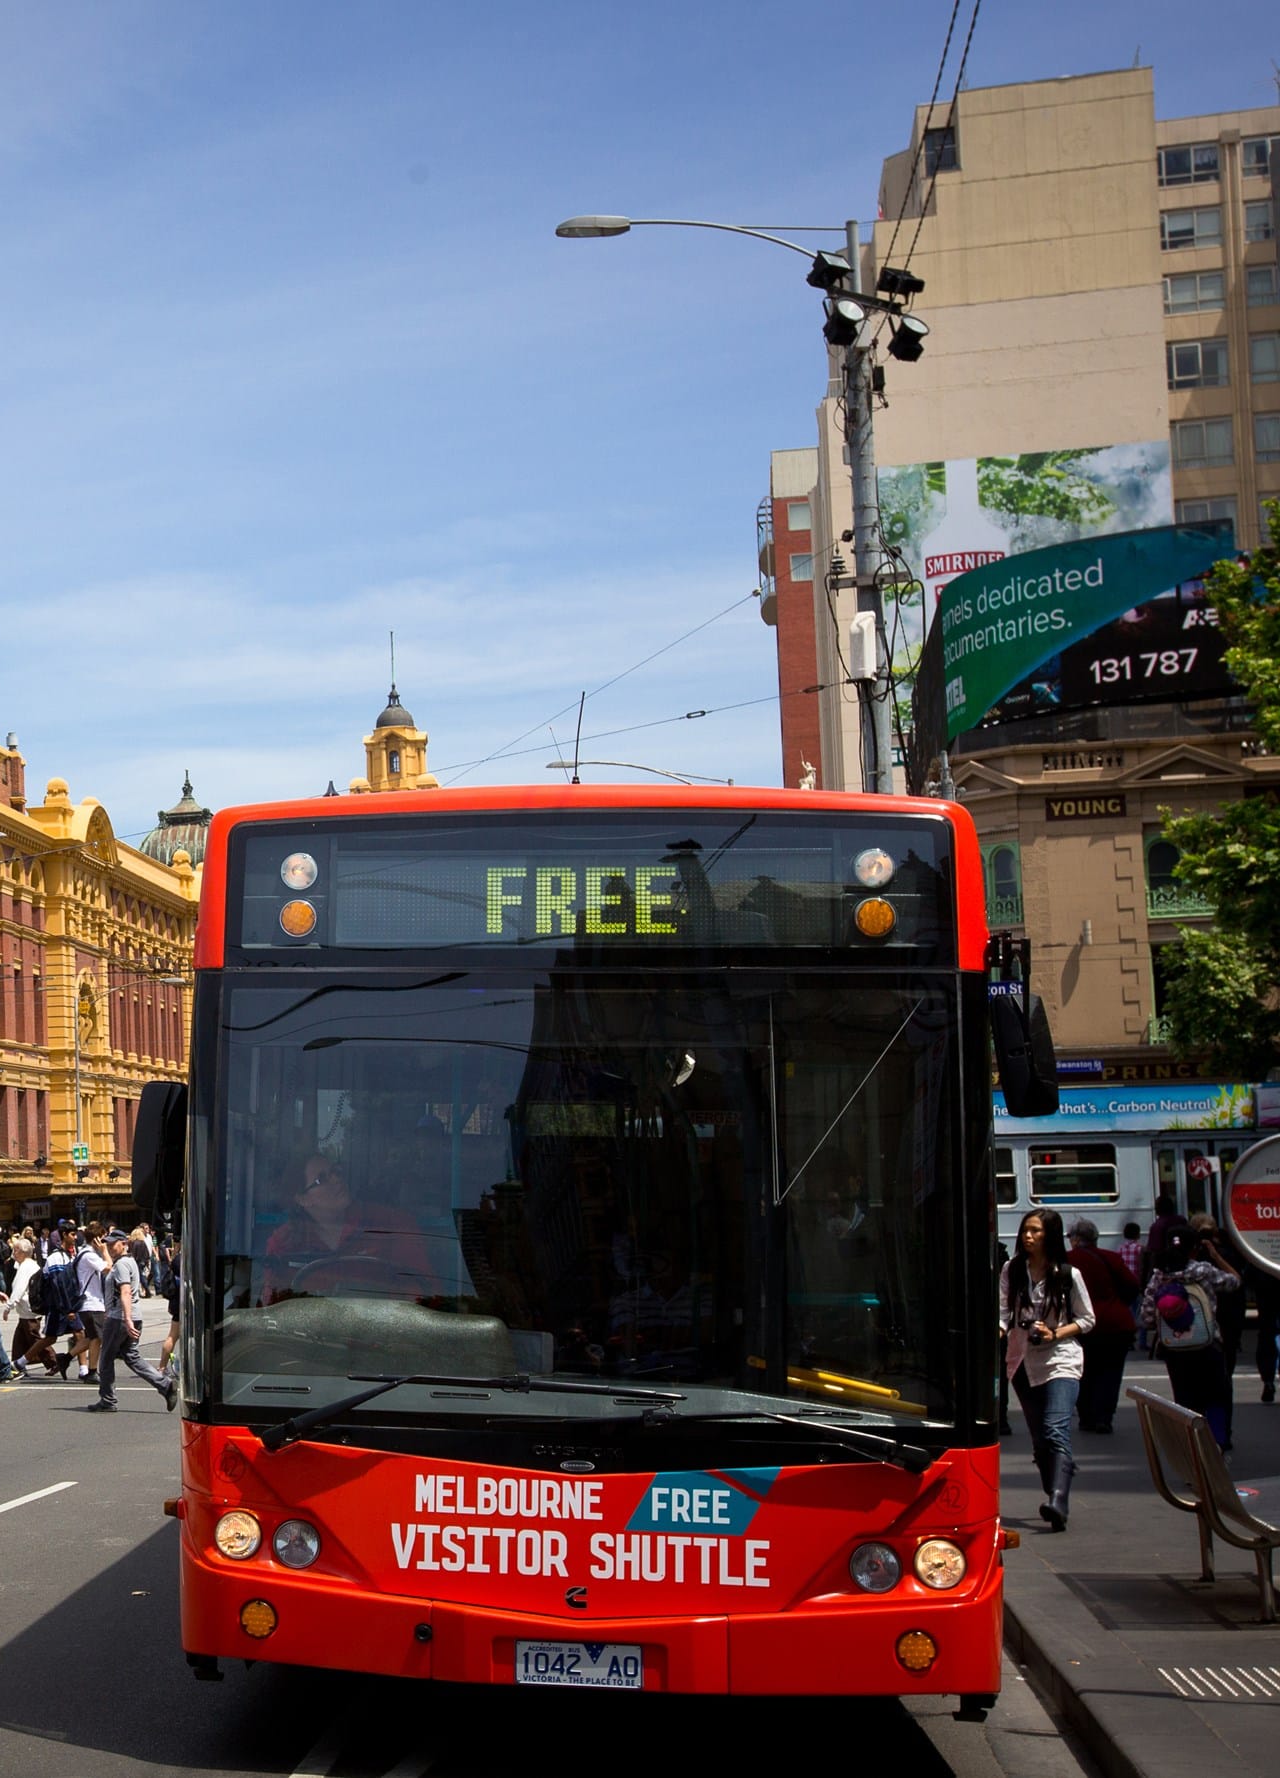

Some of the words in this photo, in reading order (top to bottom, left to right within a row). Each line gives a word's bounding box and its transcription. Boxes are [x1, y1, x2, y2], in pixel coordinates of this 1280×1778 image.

[976, 557, 1104, 615] dedicated
[1089, 655, 1131, 684] 131
[1139, 647, 1198, 678] 787
[1050, 799, 1121, 817] YOUNG
[486, 866, 677, 934] FREE
[1009, 983, 1023, 995] St
[1160, 1098, 1211, 1112] Neutral
[414, 1473, 604, 1521] MELBOURNE
[650, 1487, 731, 1524] FREE
[391, 1522, 569, 1578] VISITOR
[589, 1532, 771, 1588] SHUTTLE
[528, 1645, 562, 1653] ACCREDITED
[522, 1652, 582, 1676] 1042
[523, 1675, 561, 1683] VICTORIA
[569, 1676, 585, 1684] THE
[586, 1677, 609, 1686] PLACE
[610, 1678, 623, 1686] TO
[625, 1679, 636, 1687] BE
